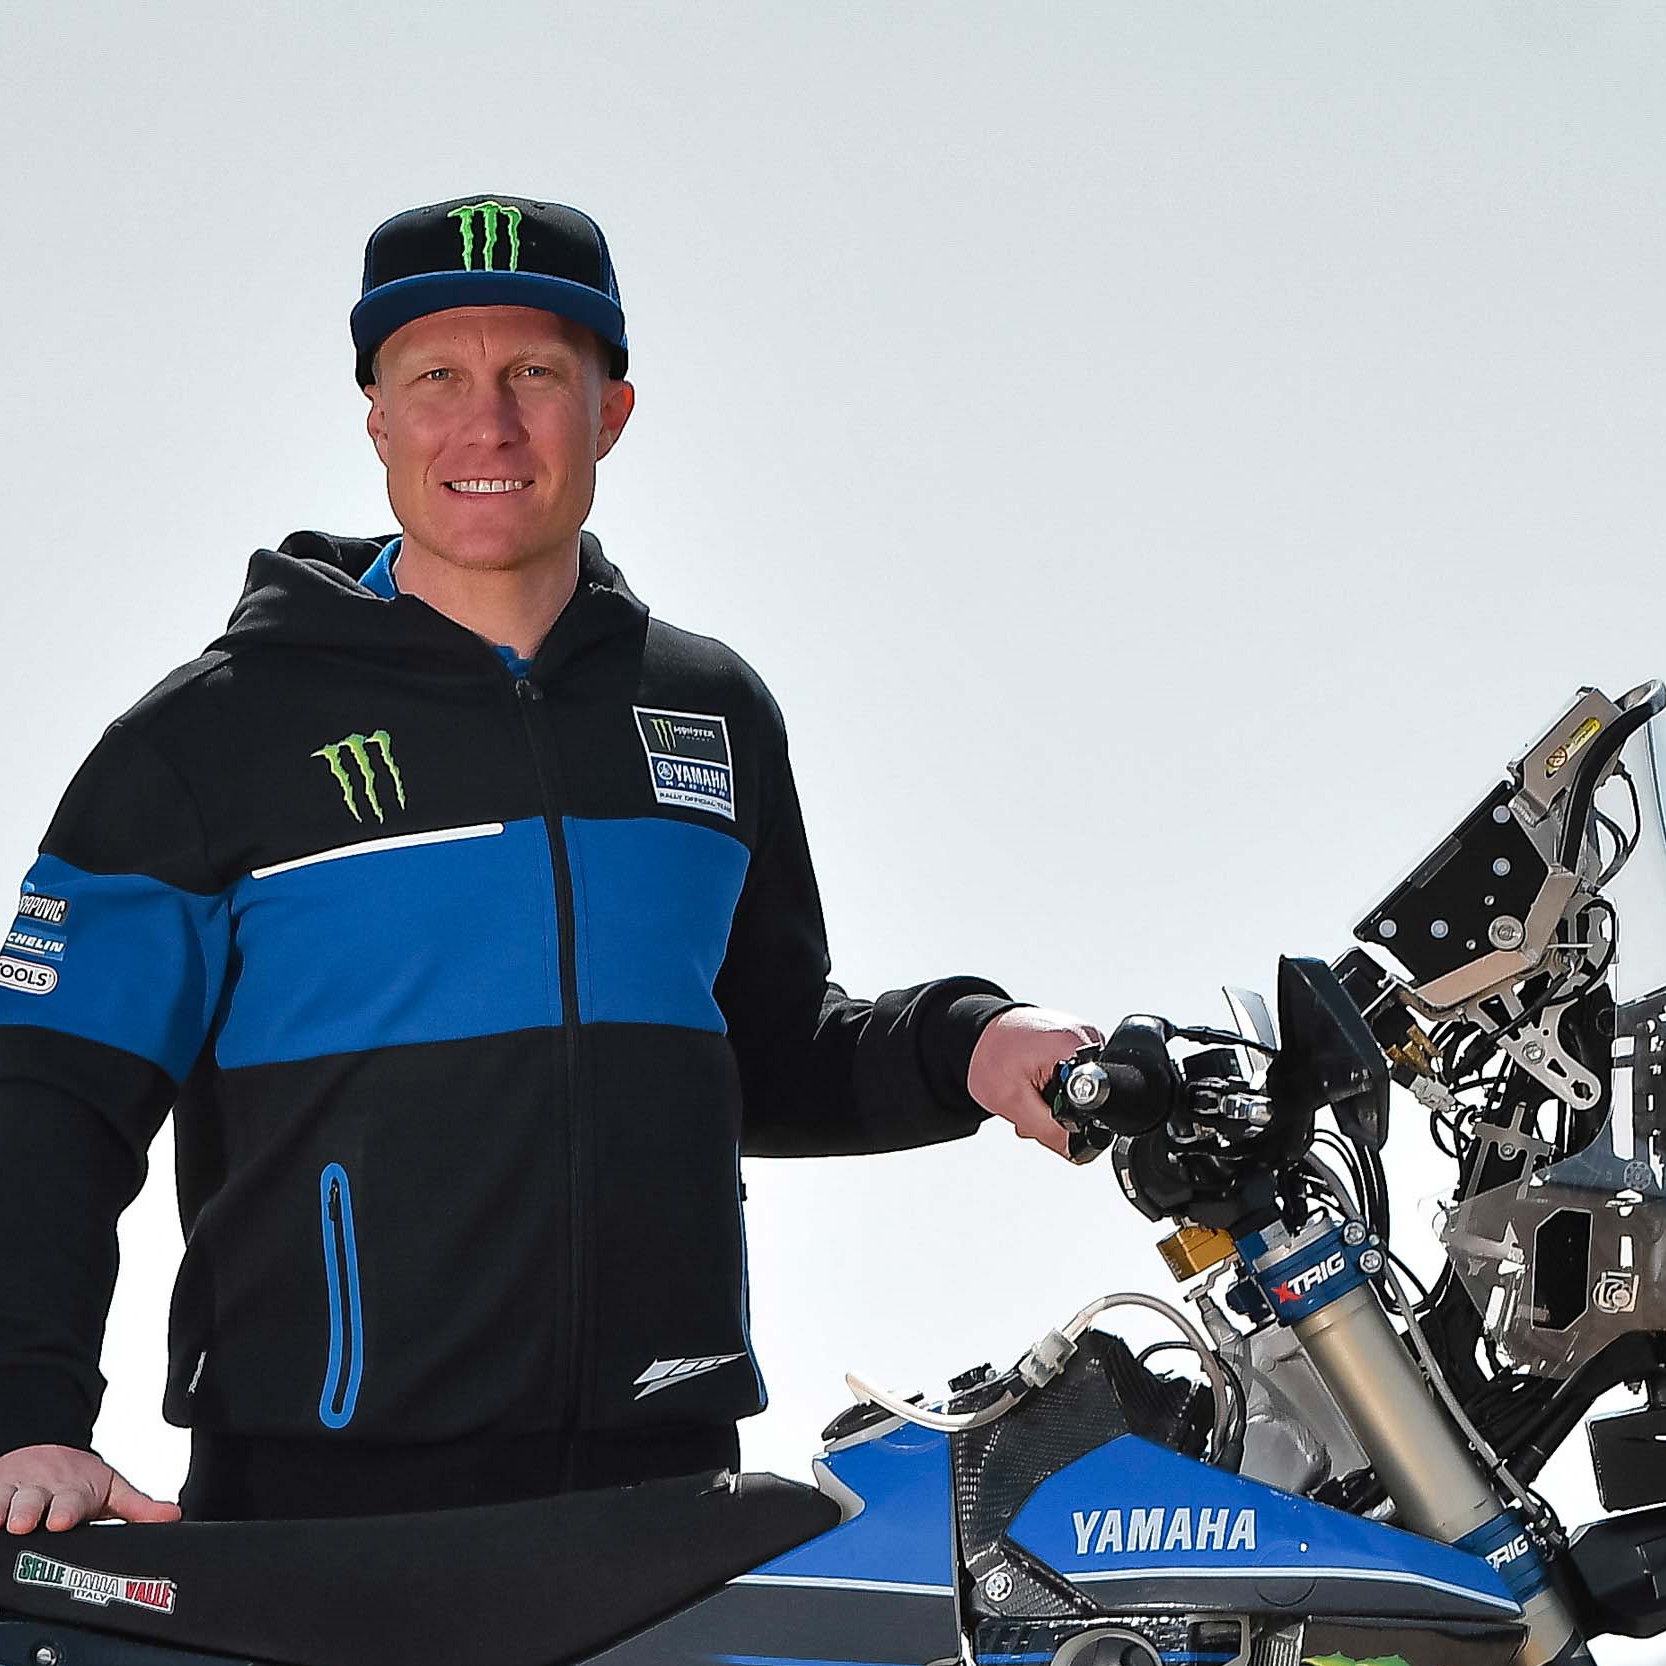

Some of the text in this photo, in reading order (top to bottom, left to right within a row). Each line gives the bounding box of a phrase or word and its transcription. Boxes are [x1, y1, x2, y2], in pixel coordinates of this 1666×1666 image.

[673, 763, 728, 792] YAMAHA
[7, 932, 64, 953] CHELIN
[1270, 1250, 1345, 1304] XTRIG
[1072, 1507, 1256, 1555] YAMAHA
[18, 1554, 171, 1609] SELLE DALLA VALLE
[76, 1588, 108, 1602] ITALY
